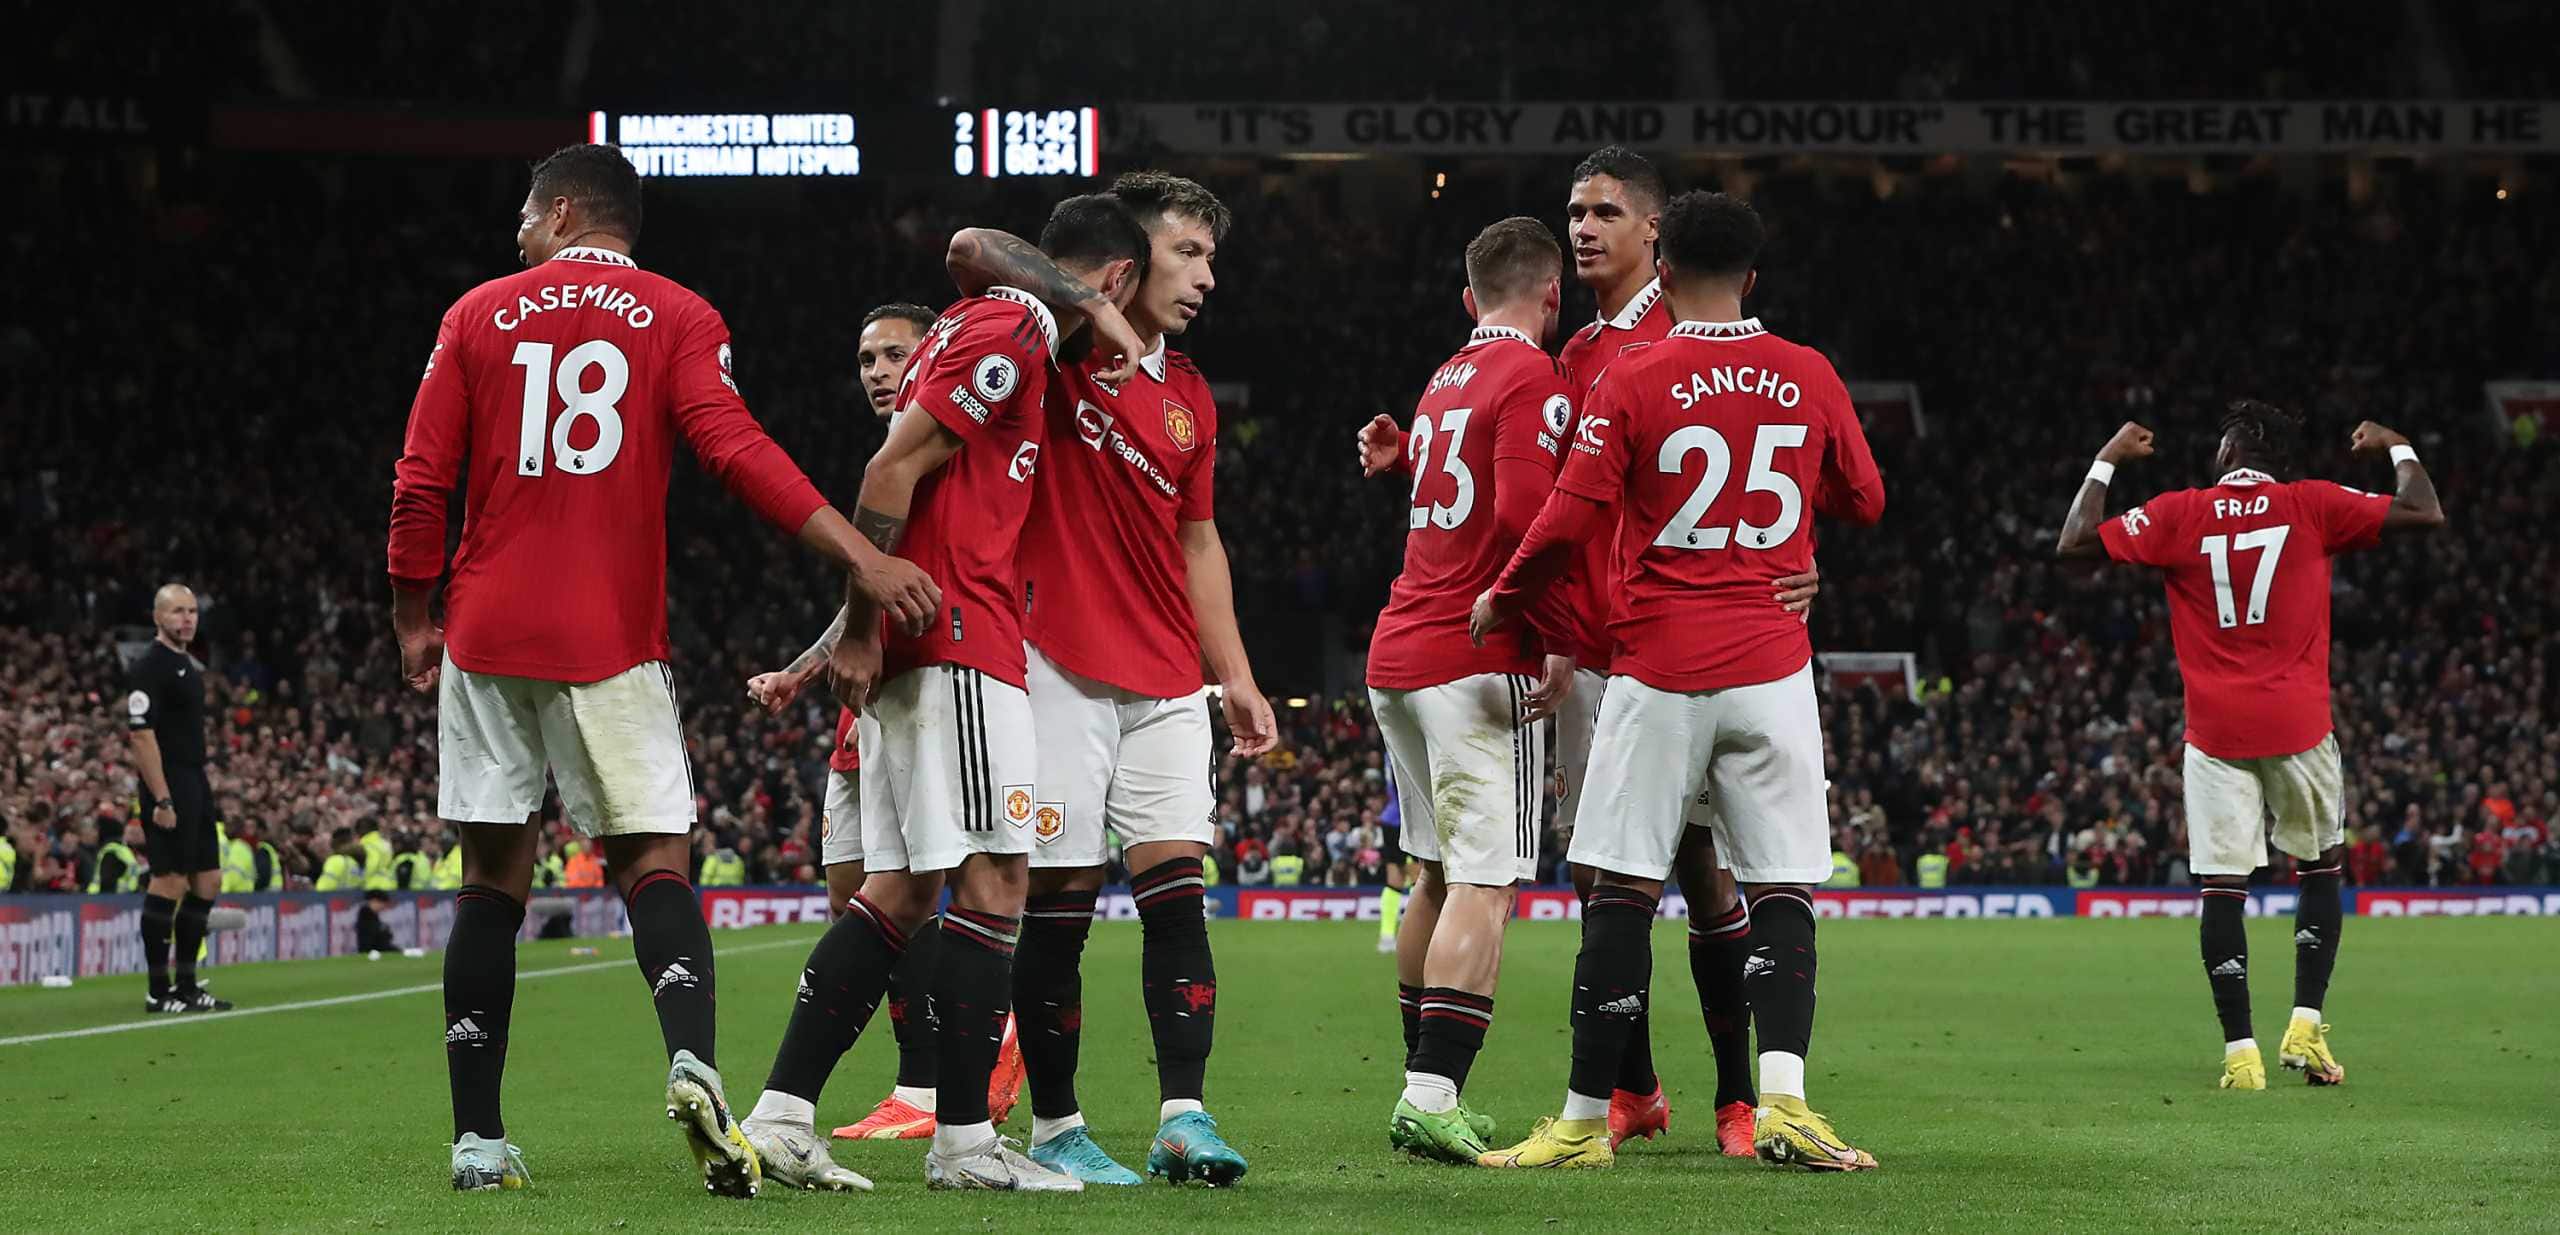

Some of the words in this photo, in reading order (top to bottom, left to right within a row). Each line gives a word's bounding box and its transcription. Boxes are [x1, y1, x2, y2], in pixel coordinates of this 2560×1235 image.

[59, 96, 149, 134] ALL
[620, 116, 768, 144] MANCHESTER
[773, 115, 853, 143] UNITED
[956, 112, 973, 143] 2
[1006, 111, 1076, 143] 21:42
[1346, 106, 1522, 145] GLORY
[1552, 106, 1664, 143] AND
[1979, 106, 2085, 143] THE
[2114, 106, 2291, 143] GREAT
[2322, 105, 2443, 141] MAN
[2472, 106, 2541, 141] HE
[620, 146, 753, 175] TOTTENHAM
[757, 146, 859, 175] HOTSPUR
[956, 144, 973, 175] 0
[493, 283, 654, 331] CASEMIRO
[1428, 361, 1478, 395] SHAW
[1671, 366, 1801, 410] SANCHO
[511, 339, 629, 477] 18
[1577, 414, 1611, 447] XC
[1407, 408, 1475, 530] 23
[1652, 424, 1809, 550] 25
[2213, 495, 2270, 519] FRED
[2200, 525, 2290, 629] 17
